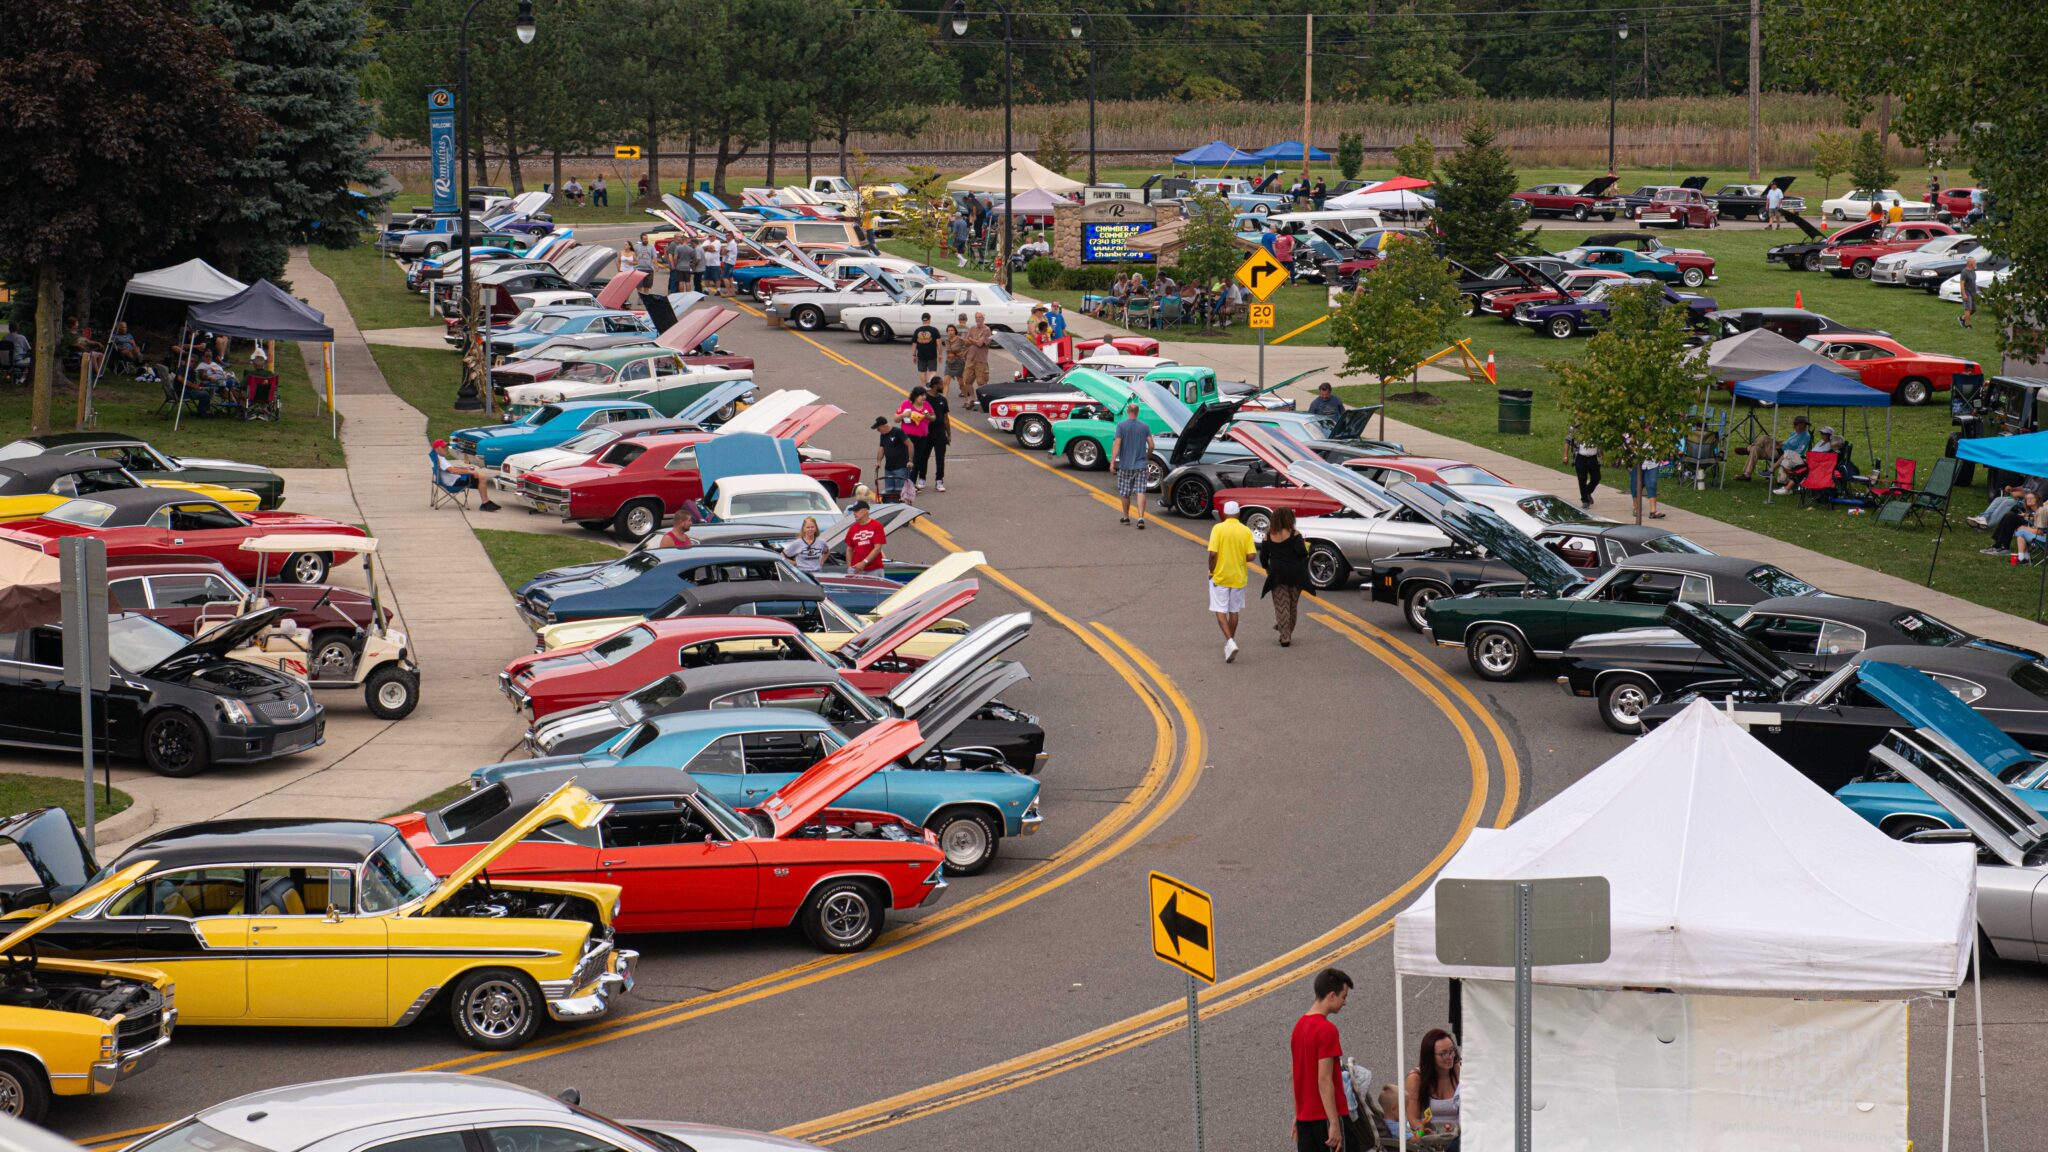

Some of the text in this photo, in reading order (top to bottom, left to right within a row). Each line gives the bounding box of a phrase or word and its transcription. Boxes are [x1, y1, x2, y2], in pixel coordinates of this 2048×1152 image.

[434, 92, 447, 104] R
[435, 135, 452, 198] Romulus
[1254, 306, 1271, 317] 20
[774, 868, 789, 876] SS
[459, 1009, 474, 1036] RADIAL
